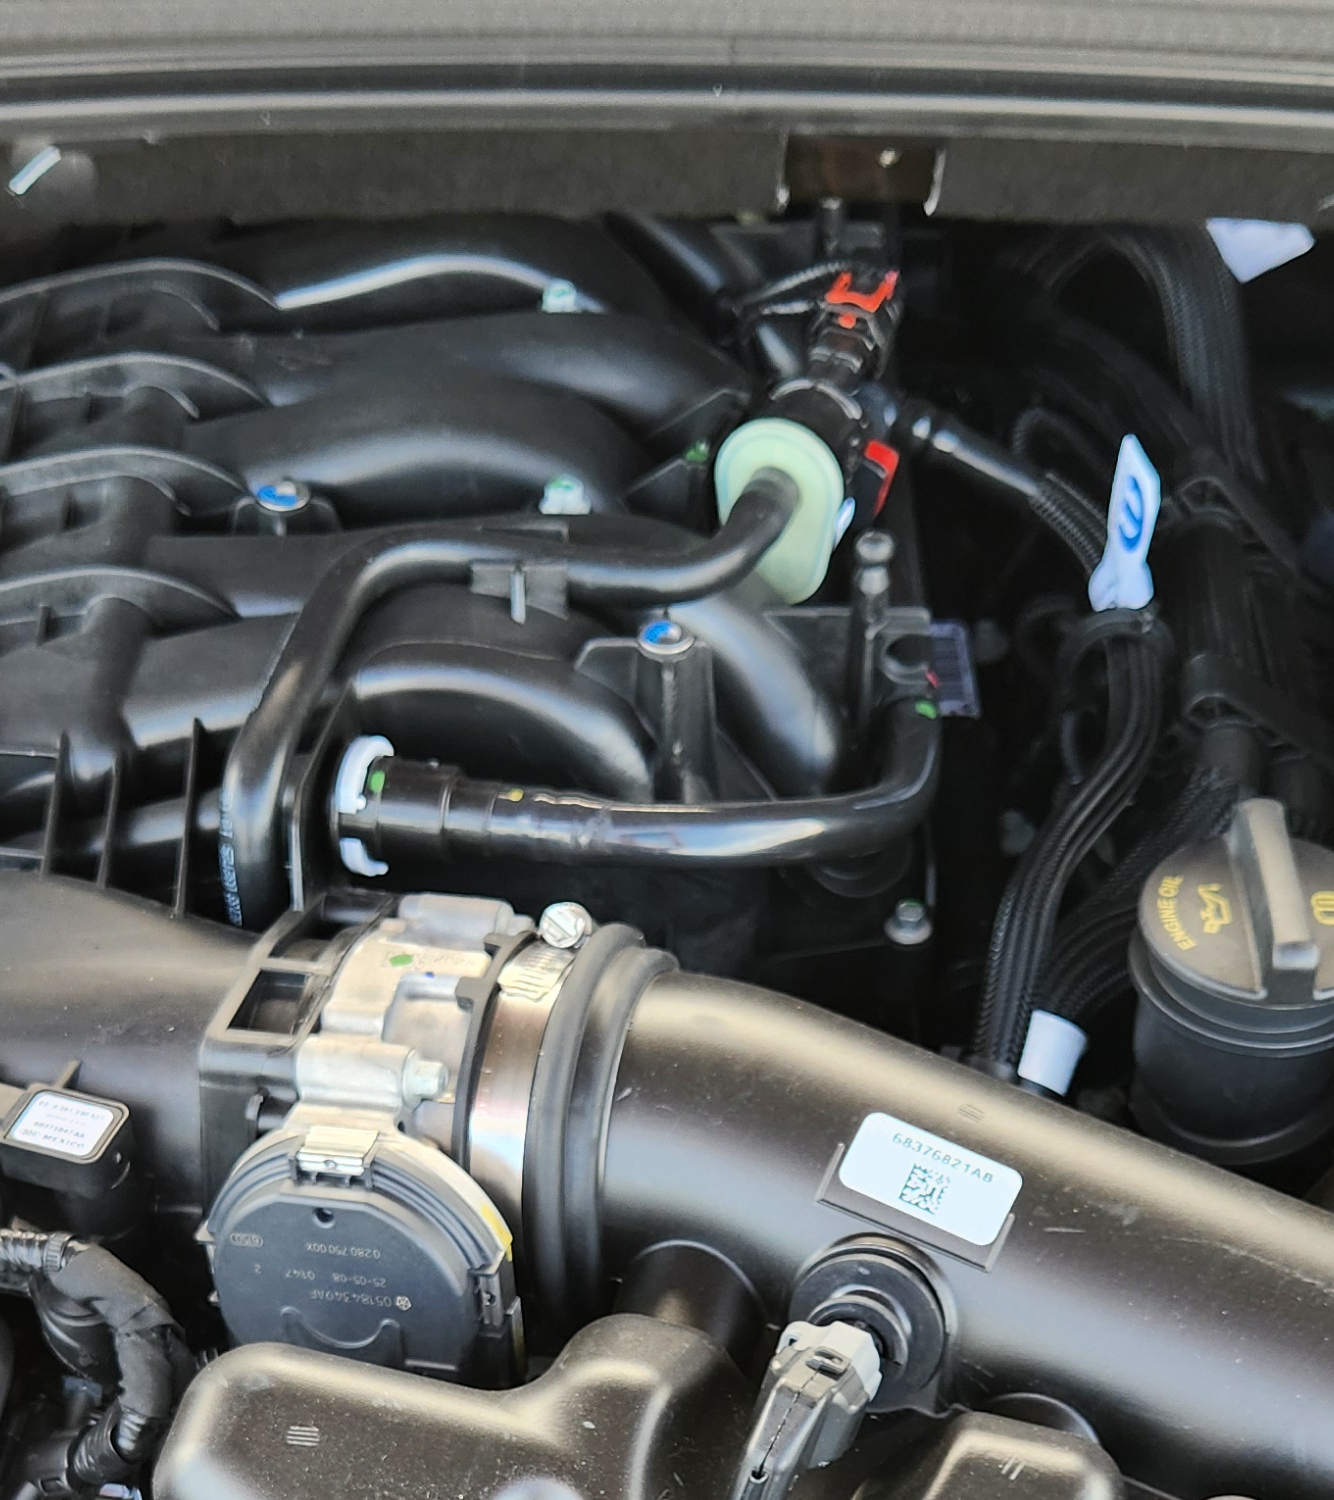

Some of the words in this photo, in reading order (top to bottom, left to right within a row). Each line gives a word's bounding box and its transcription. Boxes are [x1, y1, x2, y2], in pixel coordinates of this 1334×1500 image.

[1158, 876, 1183, 898] OIL
[1158, 898, 1197, 950] ENGINE
[892, 1132, 994, 1183] 68376821AB
[309, 1288, 392, 1308] 05184349AF
